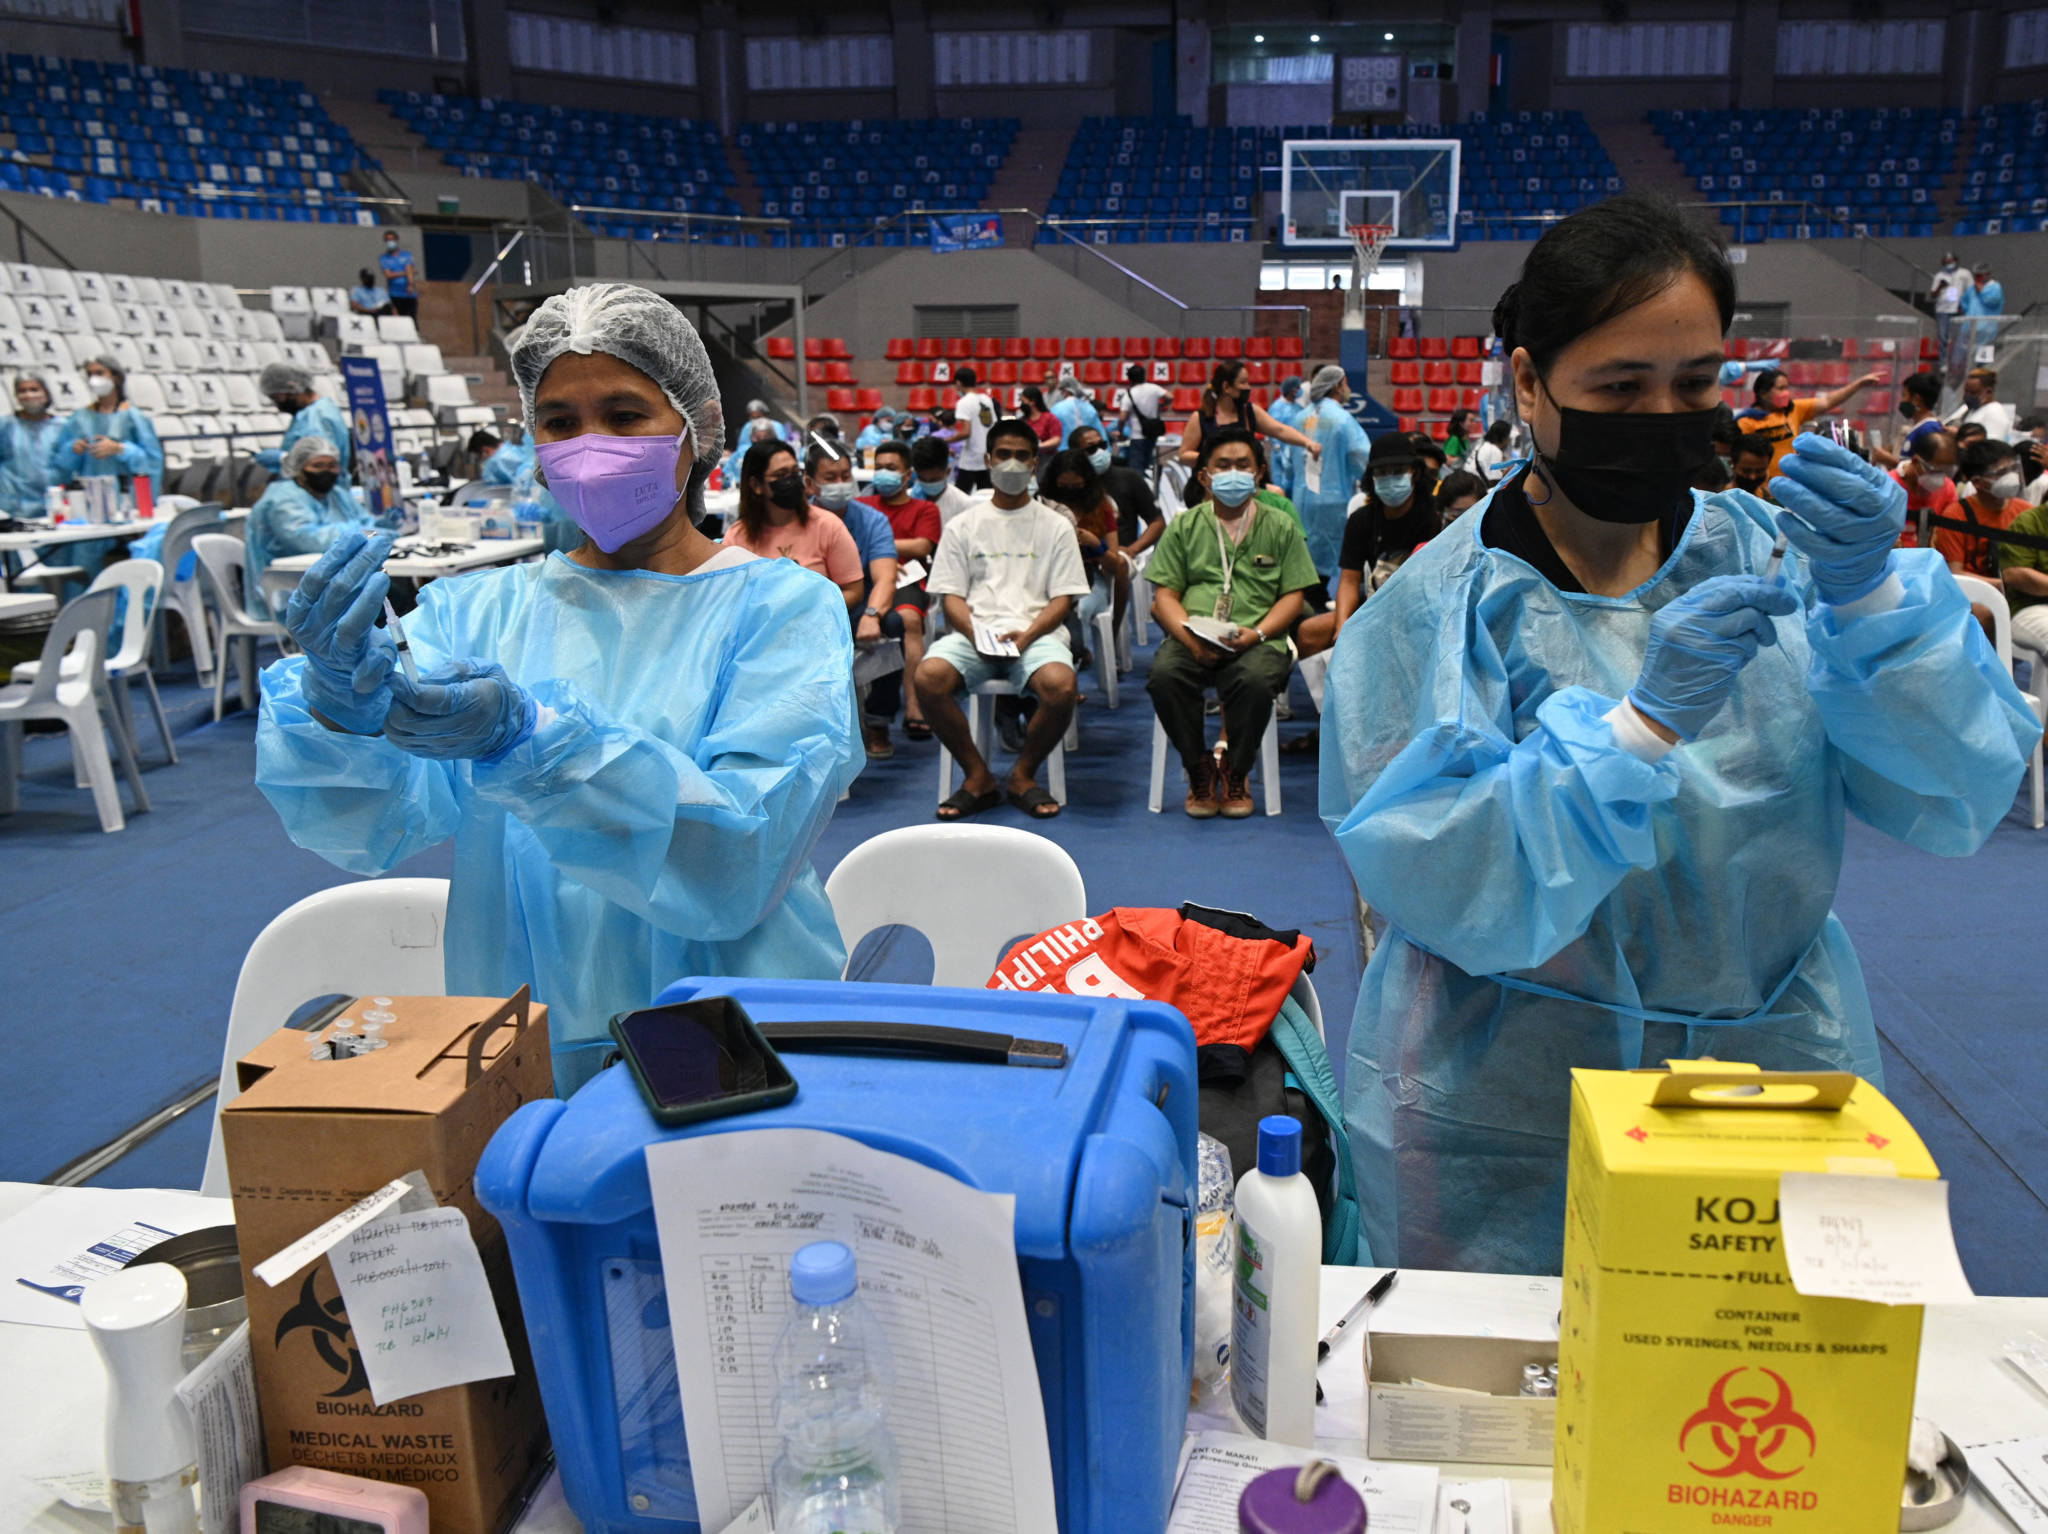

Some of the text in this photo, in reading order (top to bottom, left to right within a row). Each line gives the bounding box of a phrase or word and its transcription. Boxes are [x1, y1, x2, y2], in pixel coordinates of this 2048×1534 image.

[1696, 1197, 1780, 1224] KOJ
[1690, 1233, 1776, 1252] SAFETY
[1737, 1271, 1785, 1285] FULL
[1715, 1308, 1801, 1322] CONTAINER
[1744, 1325, 1773, 1337] FOR
[1623, 1333, 1888, 1355] USED SYRINGES, NEEDLES & SHARPS
[316, 1402, 424, 1417] BIOHAZARD
[289, 1430, 454, 1449] MEDICAL WASTE
[1225, 1449, 1259, 1462] MAKATI
[1667, 1484, 1818, 1510] BIOHAZARD
[1711, 1512, 1773, 1527] DANGER
